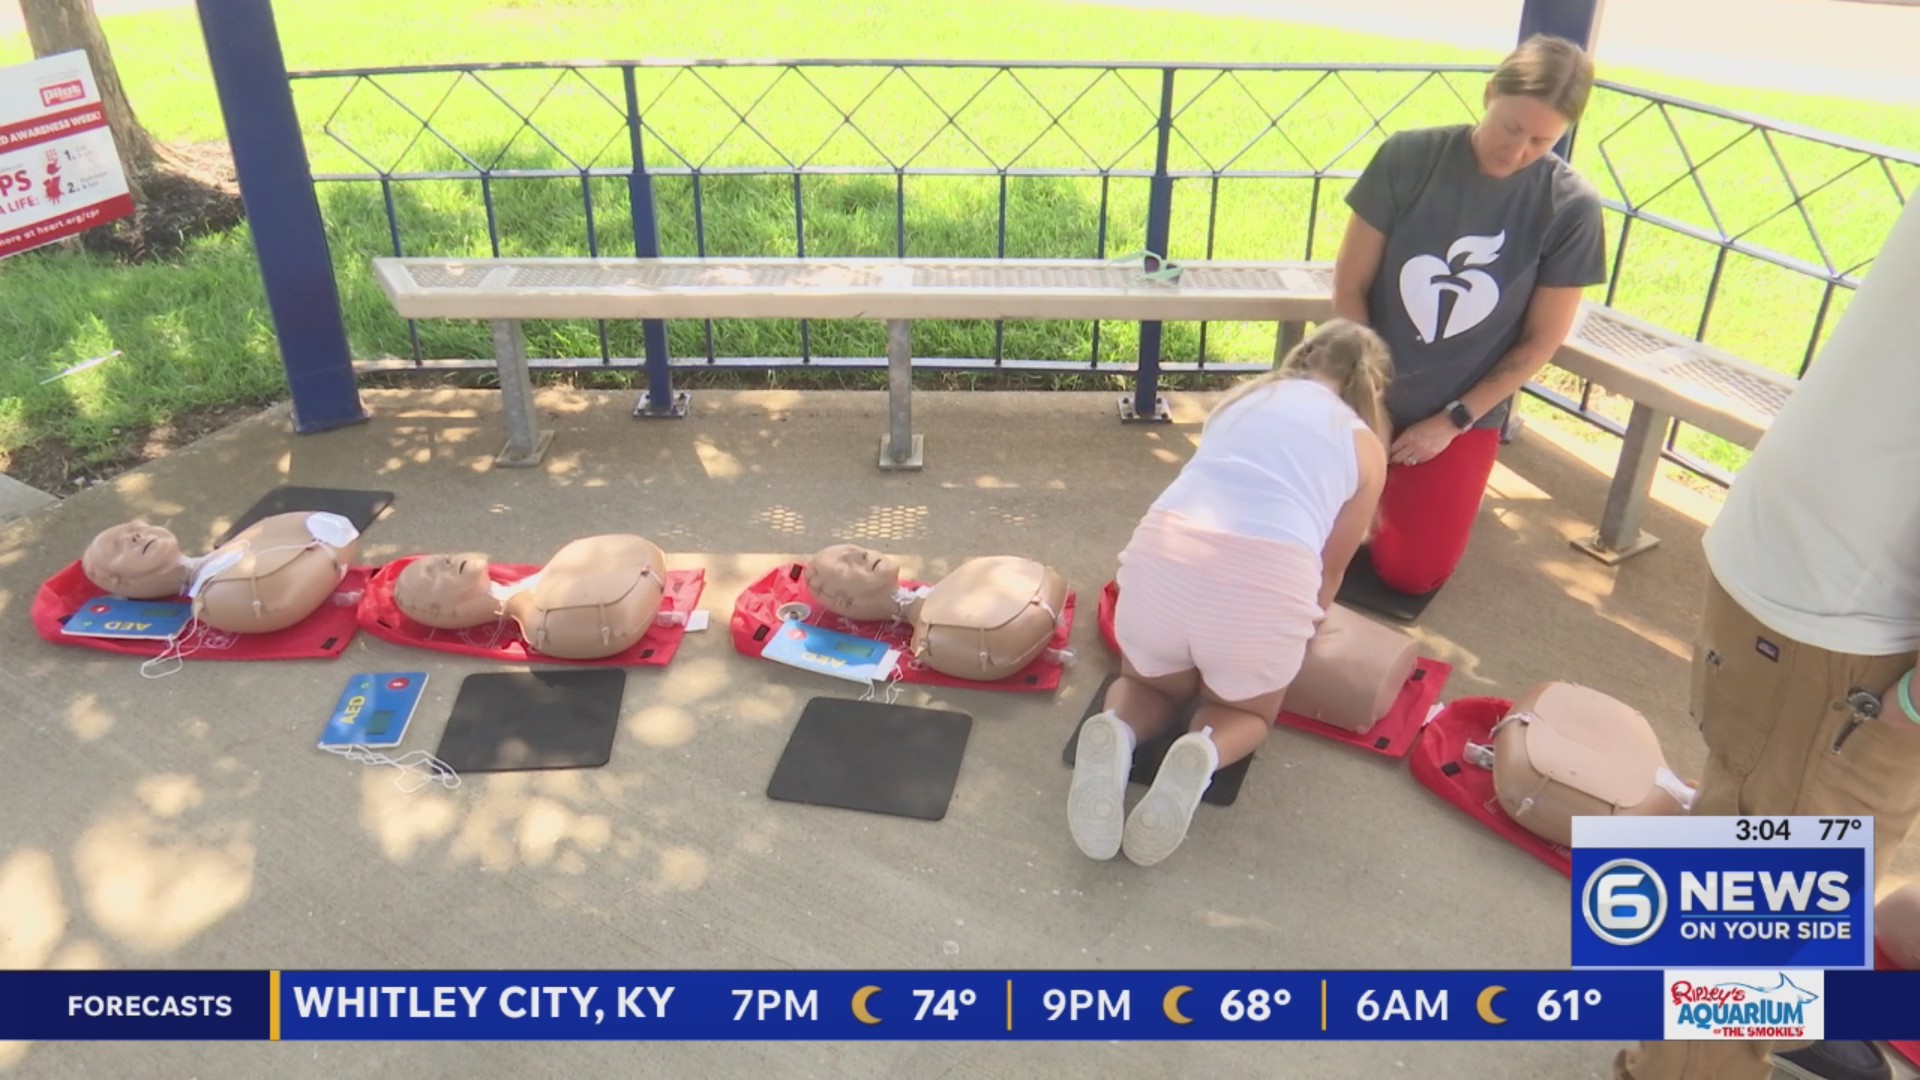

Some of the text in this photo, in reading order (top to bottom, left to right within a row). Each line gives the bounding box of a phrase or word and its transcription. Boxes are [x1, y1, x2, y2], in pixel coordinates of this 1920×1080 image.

[10, 119, 71, 143] AWARENESS
[70, 110, 102, 127] WEEK!
[7, 195, 40, 213] LIFE:
[36, 208, 100, 234] heart.org/cpr
[104, 621, 152, 632] AED
[340, 695, 366, 725] AED
